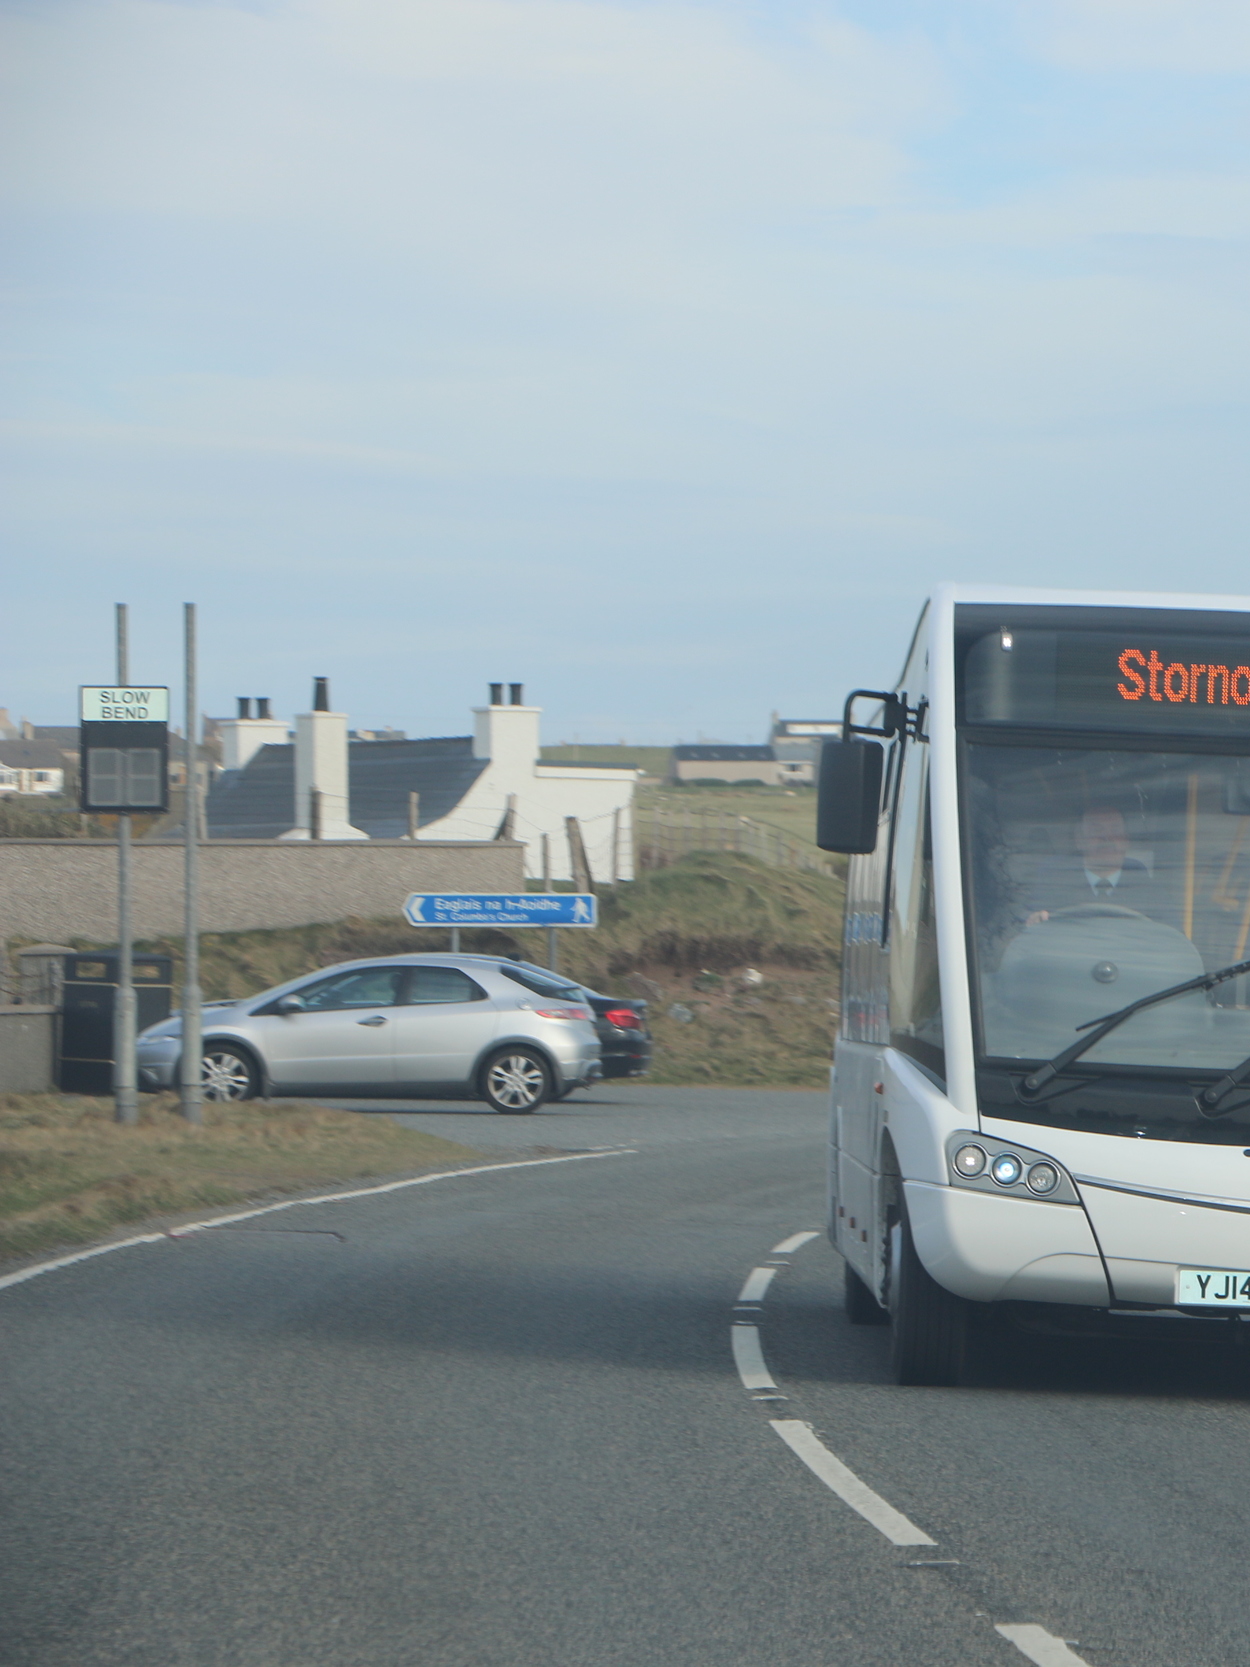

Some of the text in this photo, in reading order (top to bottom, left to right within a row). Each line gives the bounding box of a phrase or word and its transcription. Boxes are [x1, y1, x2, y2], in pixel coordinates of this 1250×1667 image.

[100, 690, 150, 704] SLOW
[101, 706, 149, 719] BEND
[485, 900, 502, 910] na
